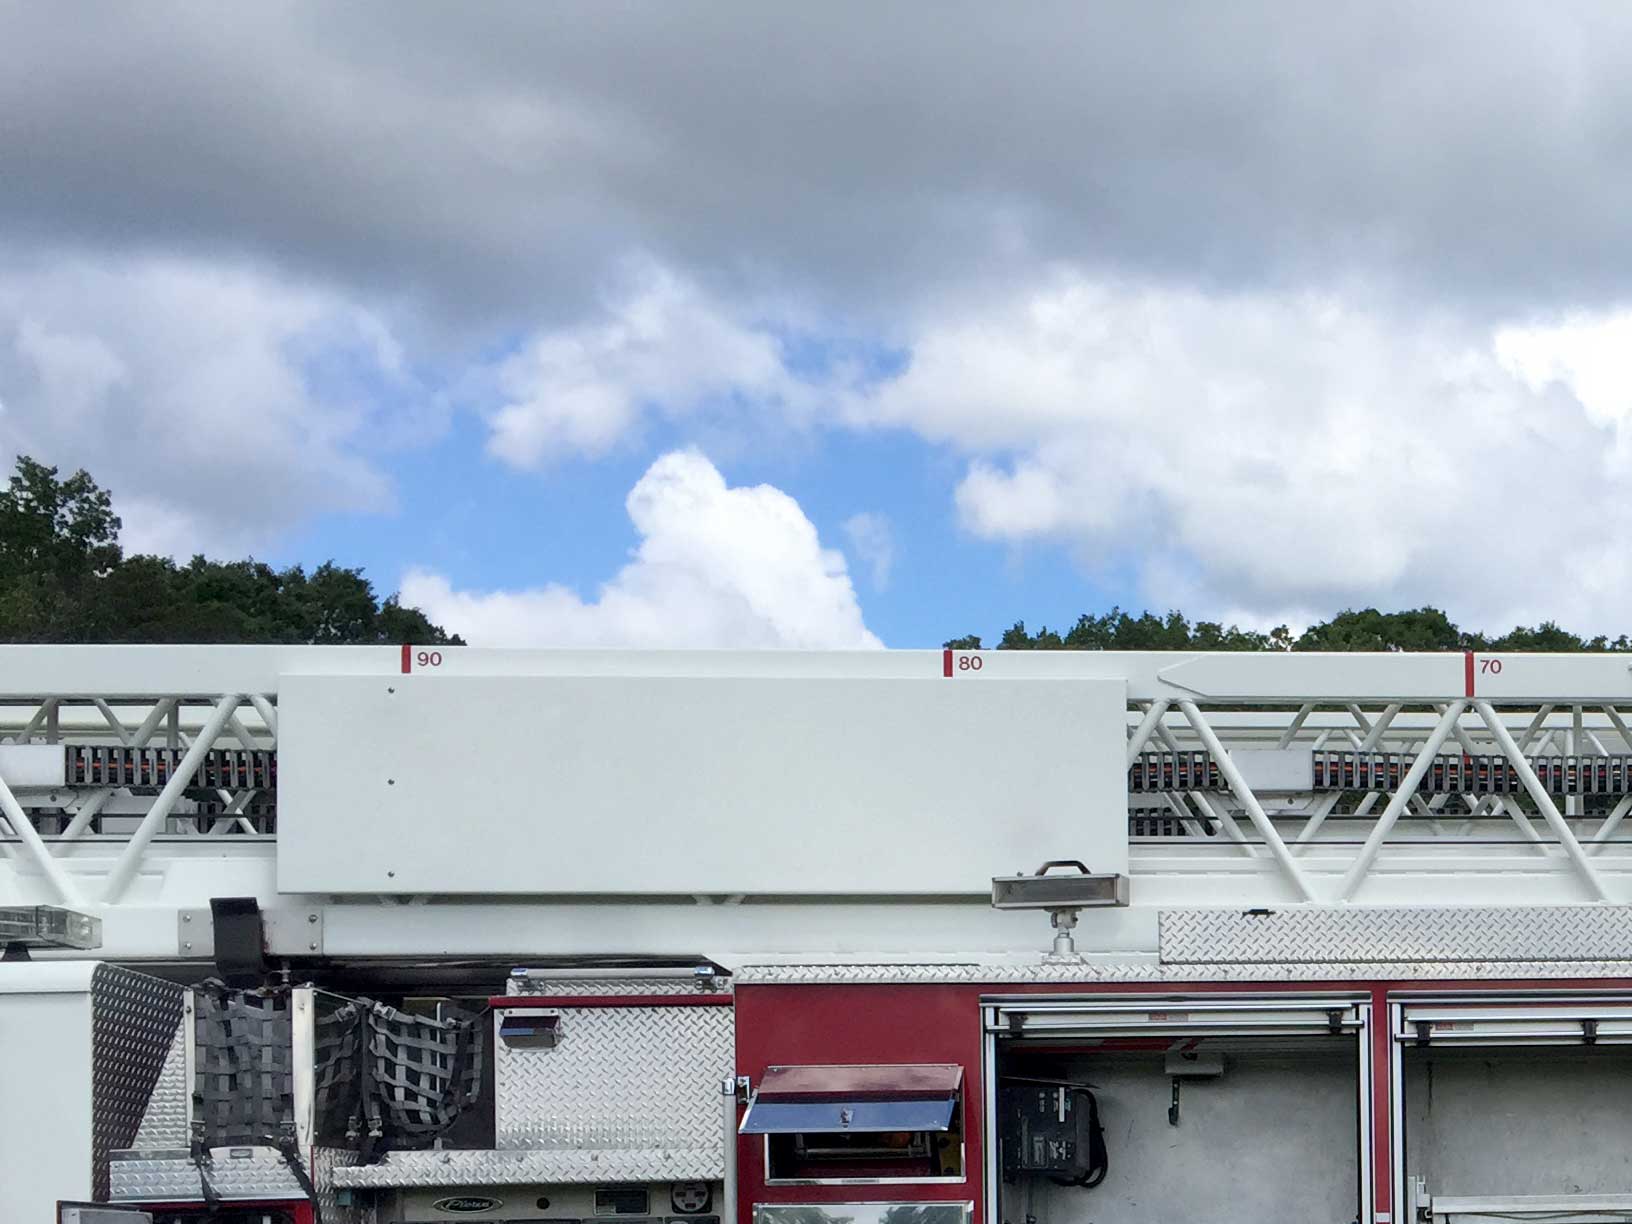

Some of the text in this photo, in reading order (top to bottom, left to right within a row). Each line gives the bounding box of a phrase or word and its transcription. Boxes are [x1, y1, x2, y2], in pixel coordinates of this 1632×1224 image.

[417, 651, 442, 666] 90
[959, 656, 983, 671] 80
[1480, 659, 1502, 674] 70
